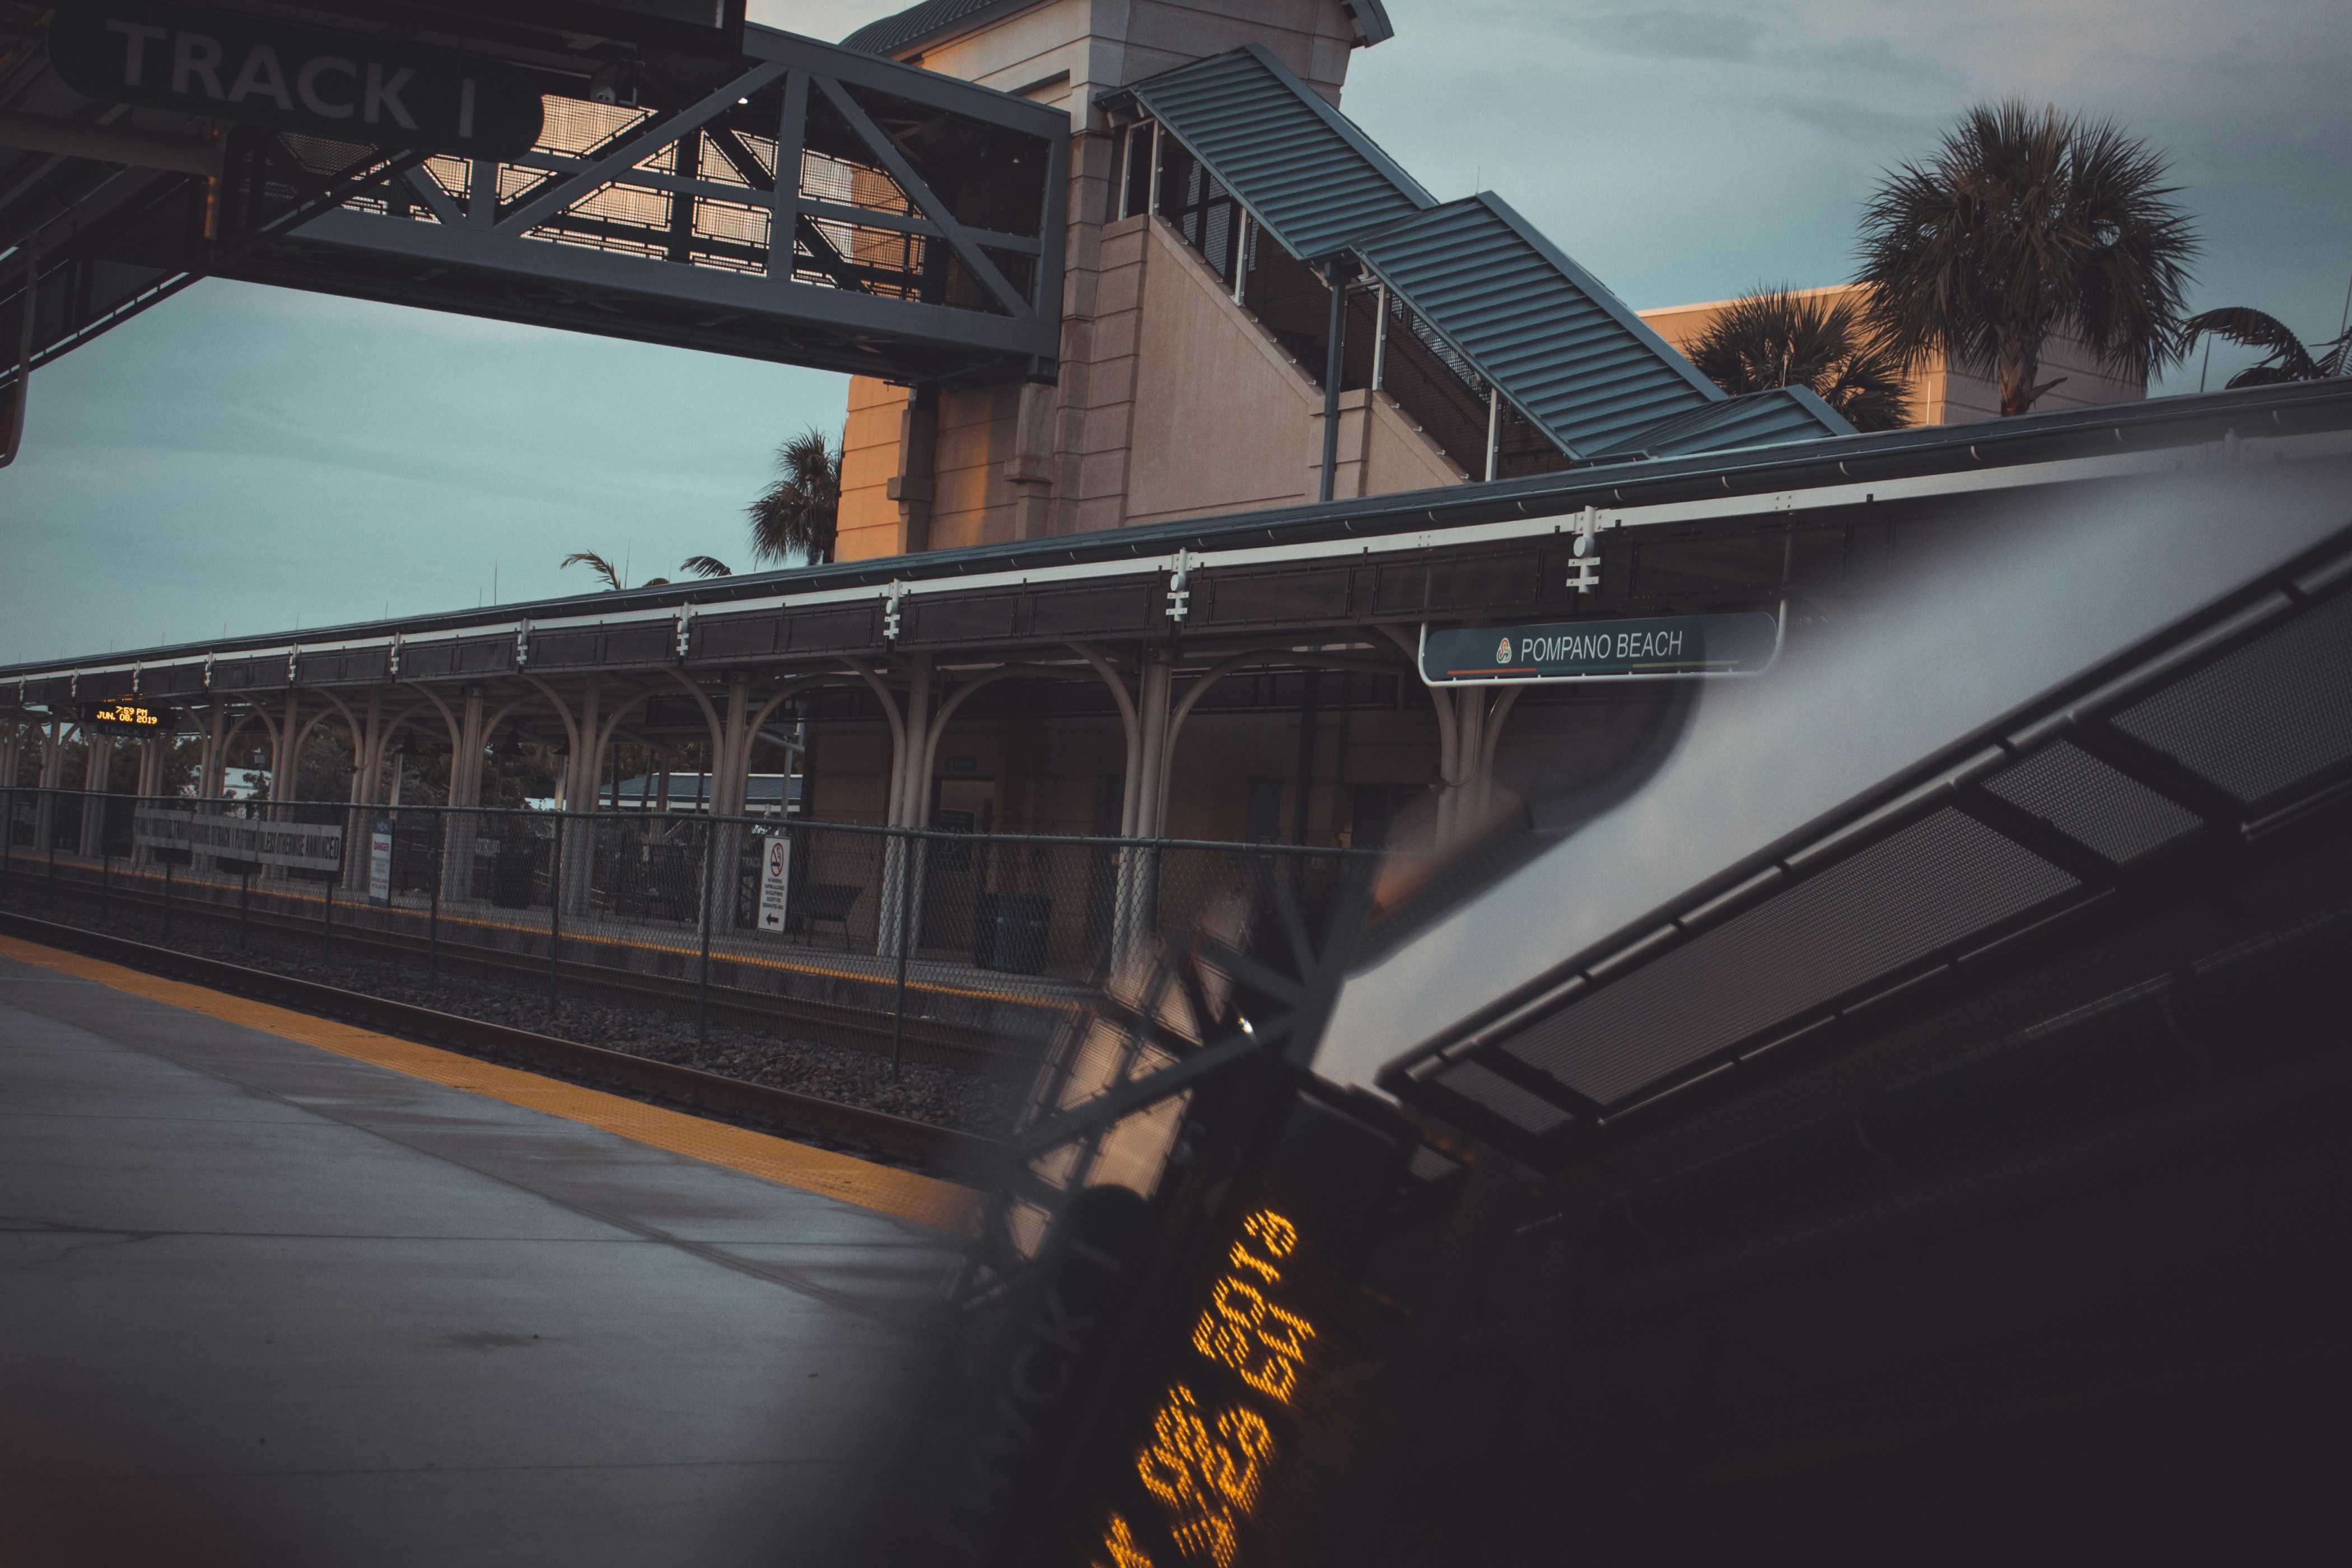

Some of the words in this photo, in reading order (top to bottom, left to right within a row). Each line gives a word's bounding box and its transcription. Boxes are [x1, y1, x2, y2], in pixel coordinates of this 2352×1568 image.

[106, 18, 419, 130] TRACK
[1521, 634, 1611, 662] POMPANO
[1616, 631, 1683, 658] BEACH
[115, 706, 135, 715] 7:59
[136, 708, 148, 716] PM
[97, 711, 116, 721] JUN.
[136, 715, 157, 725] 2019
[105, 725, 141, 736] TRACK
[374, 841, 390, 852] DANGER
